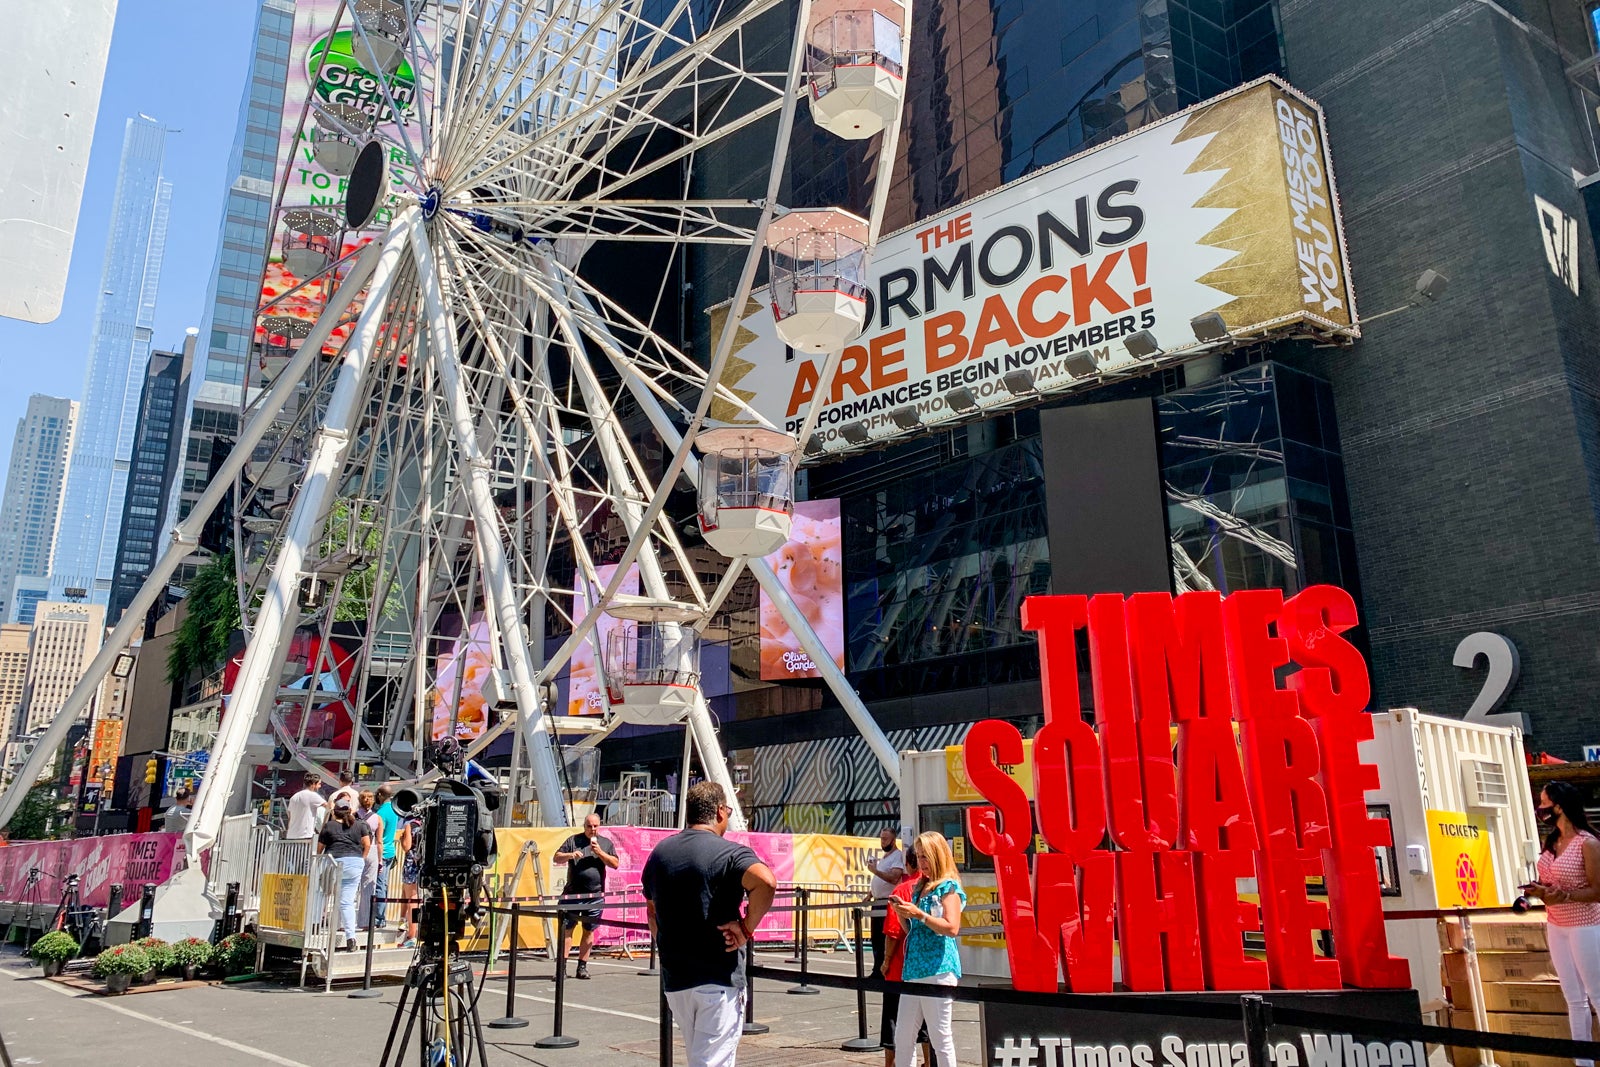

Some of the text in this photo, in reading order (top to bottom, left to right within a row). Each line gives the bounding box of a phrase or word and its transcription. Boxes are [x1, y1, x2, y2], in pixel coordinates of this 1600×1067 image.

[916, 212, 973, 253] THE
[1276, 98, 1321, 303] WE MISSED
[1294, 107, 1343, 312] YOU TOO!
[785, 179, 1146, 362] RMONS
[924, 241, 1152, 374] BACK!
[785, 327, 908, 417] ARE
[786, 308, 1156, 434] PEFORMANCES BEGIN NOVEMBER 5
[782, 651, 808, 662] Olive
[786, 659, 817, 673] Garde
[1021, 584, 1371, 726] TIMES
[1452, 631, 1528, 735] 2
[964, 713, 1392, 855] SQUARE
[124, 861, 163, 880] SQUARE
[128, 841, 158, 860] TIMES
[843, 845, 884, 872] TIME
[1439, 823, 1479, 839] TICKETS
[122, 883, 142, 901] WHE
[994, 846, 1411, 993] WHEEL
[1161, 1035, 1299, 1067] Squae
